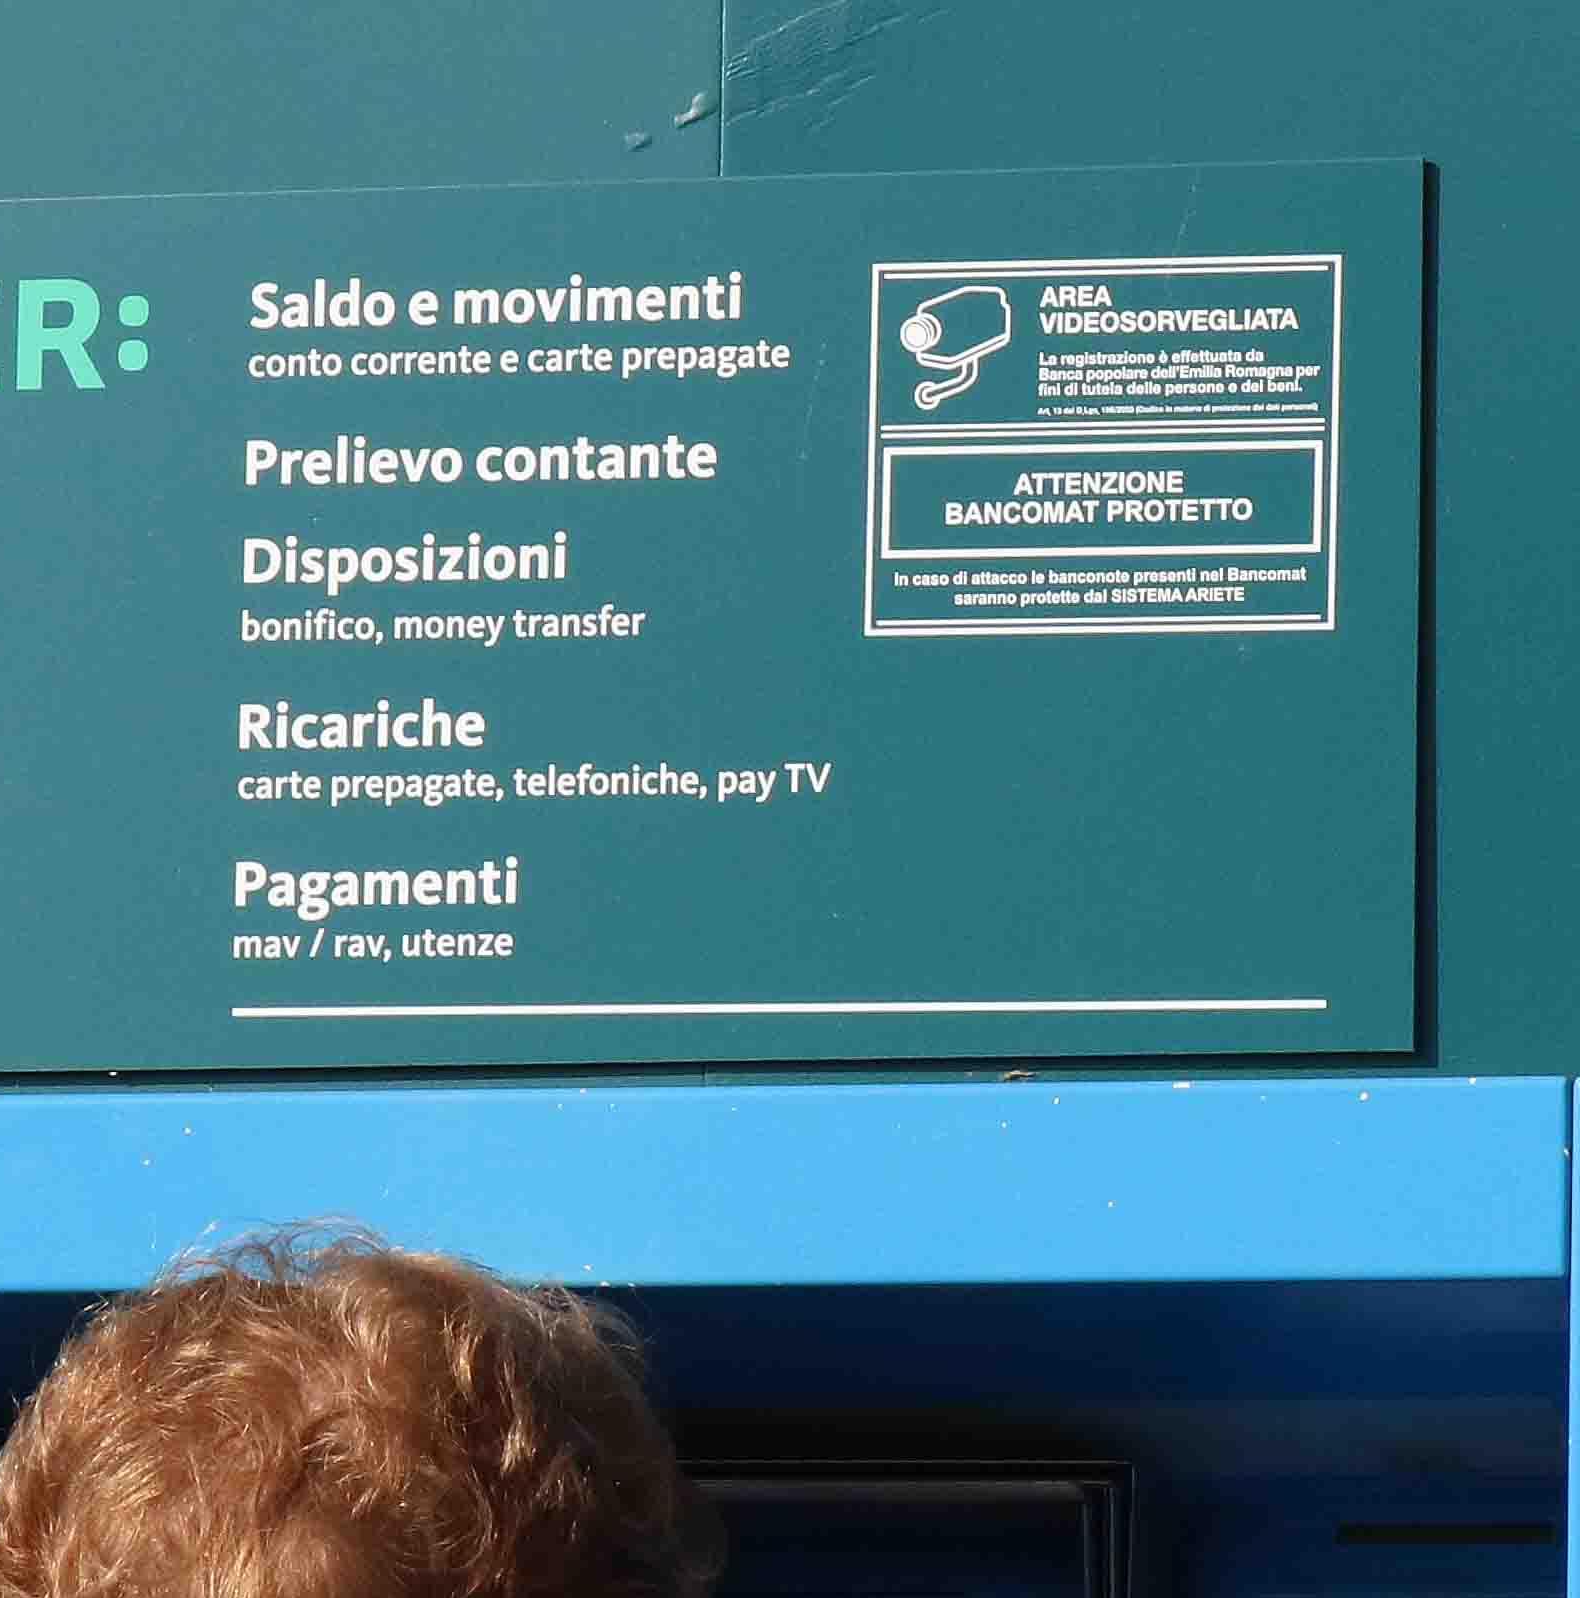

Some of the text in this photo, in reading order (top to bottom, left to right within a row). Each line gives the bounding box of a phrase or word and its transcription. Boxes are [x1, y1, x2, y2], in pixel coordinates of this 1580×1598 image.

[250, 272, 741, 328] Saldo e movimenti
[1039, 285, 1112, 308] AREA
[1039, 308, 1299, 335] VIDEOSORVEGLIATA
[249, 340, 790, 378] conto corrente e carte prepagate
[1038, 364, 1321, 382] Banca popolare dell'Emilia Romagna per
[1039, 348, 1264, 368] La registrazione è effettuata da
[1038, 379, 1303, 397] fini di tutela delle persone e dei beni.
[244, 435, 717, 485] Prelievo contante
[1013, 470, 1184, 496] ATTENZIONE
[944, 498, 1253, 526] BANCOMAT PROTETTO
[244, 531, 566, 596] Disposizioni
[895, 567, 1306, 586] In caso di attacco le banconote presenti nel Bancomat
[953, 586, 1245, 607] saranno protette dal SISTEMA ARIETE
[242, 604, 646, 647] bonifico, money transfer
[240, 698, 485, 749] Ricariche
[238, 763, 831, 807] carte prepagate, telefoniche, pay TV
[235, 856, 518, 921] Pagamenti
[234, 936, 300, 958] mav
[335, 935, 391, 962] rav,
[402, 929, 513, 957] utenze
